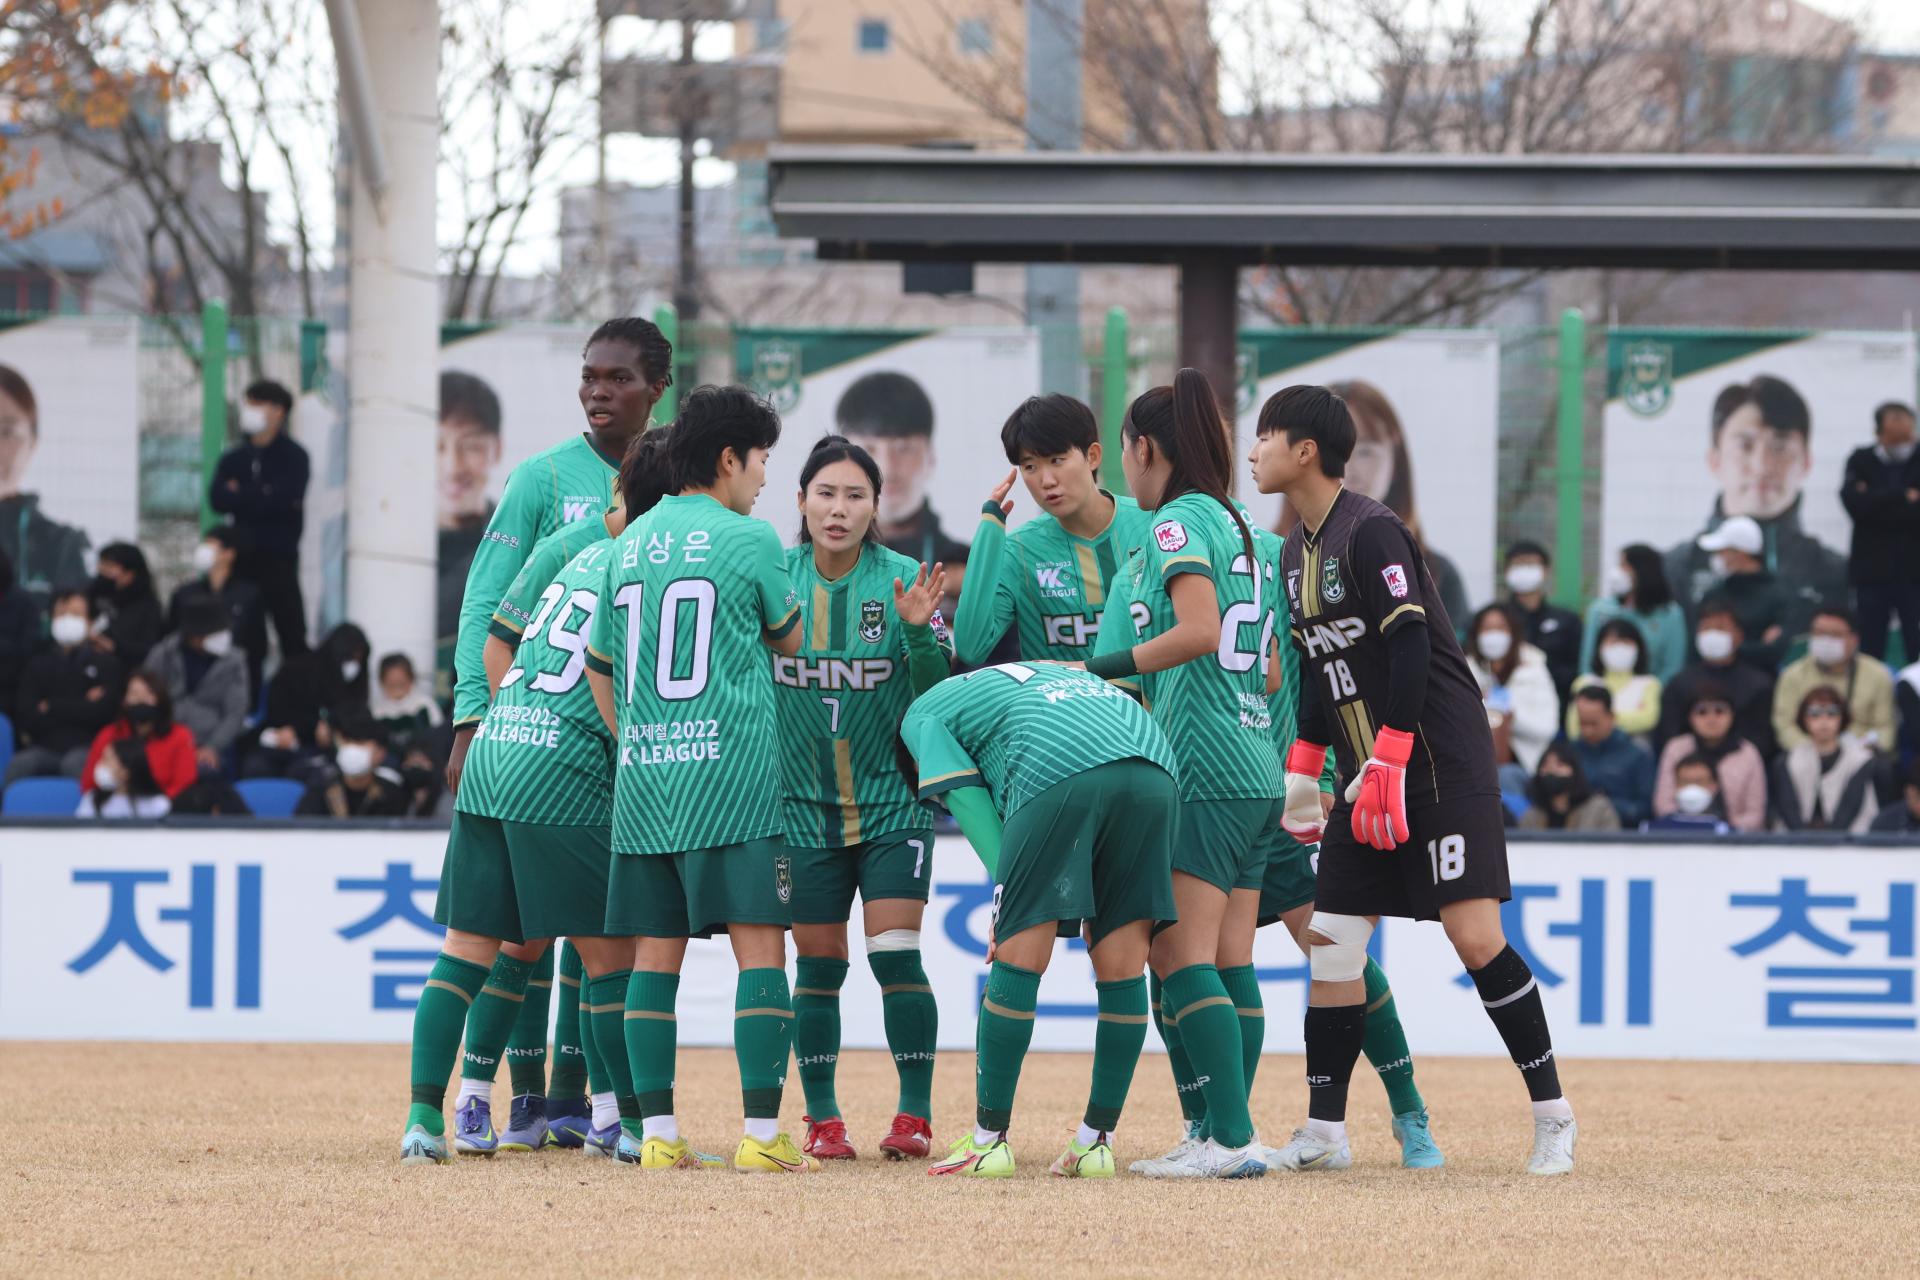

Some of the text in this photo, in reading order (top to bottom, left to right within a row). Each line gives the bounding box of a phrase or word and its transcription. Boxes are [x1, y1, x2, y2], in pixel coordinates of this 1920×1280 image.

[623, 530, 712, 569] 김상은
[1040, 587, 1077, 598] LEAGUE
[499, 581, 598, 696] 29
[613, 576, 718, 707] 10
[1302, 616, 1367, 659] HNP
[1323, 658, 1358, 701] 18
[521, 706, 561, 727] 2022
[624, 719, 719, 743] 대제철 2022
[821, 696, 840, 733] 7
[489, 724, 561, 749] LEAGUE
[640, 740, 721, 765] LEAGUE
[907, 839, 924, 878] 7
[1428, 834, 1466, 886] 18
